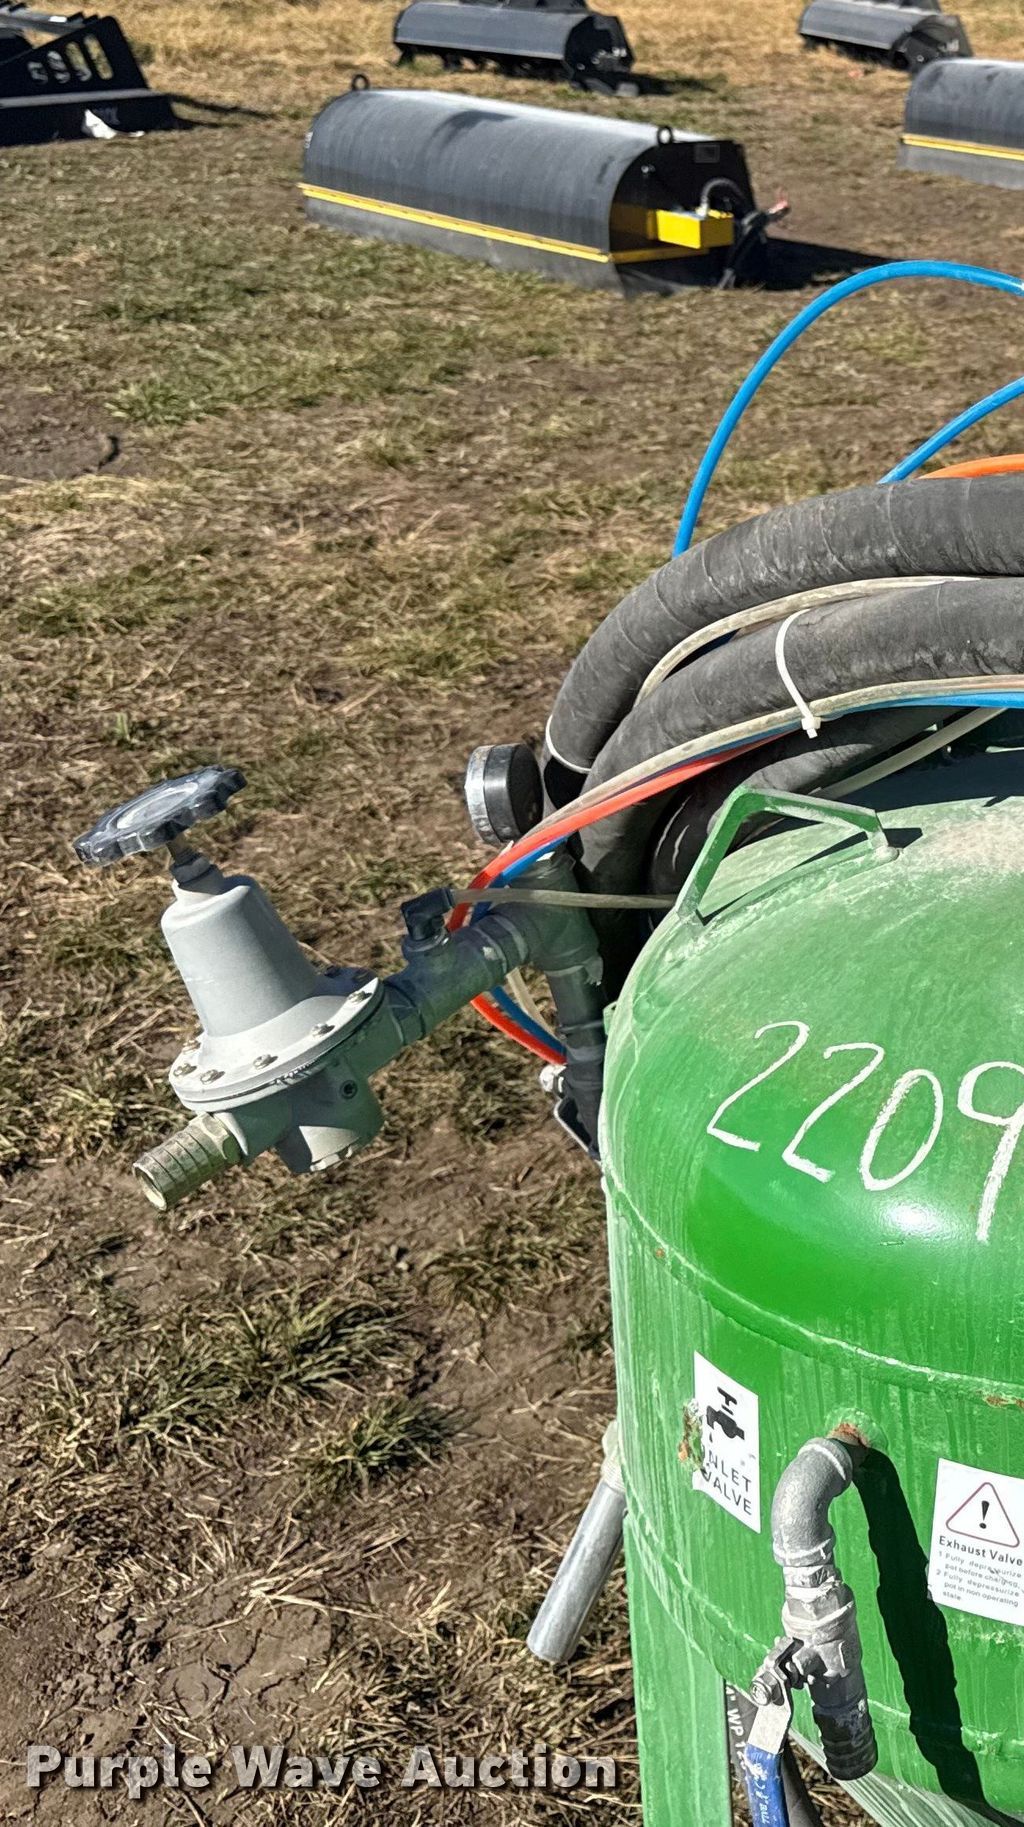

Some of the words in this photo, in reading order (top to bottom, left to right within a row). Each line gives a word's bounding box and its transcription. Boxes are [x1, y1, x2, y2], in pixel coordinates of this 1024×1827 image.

[708, 1449, 752, 1492] NLET
[939, 1535, 986, 1557] Exhaust
[990, 1550, 1023, 1566] Valve
[945, 1553, 964, 1564] Fully
[943, 1571, 962, 1583] Fully
[958, 1567, 983, 1578] before
[982, 1591, 1019, 1608] operating
